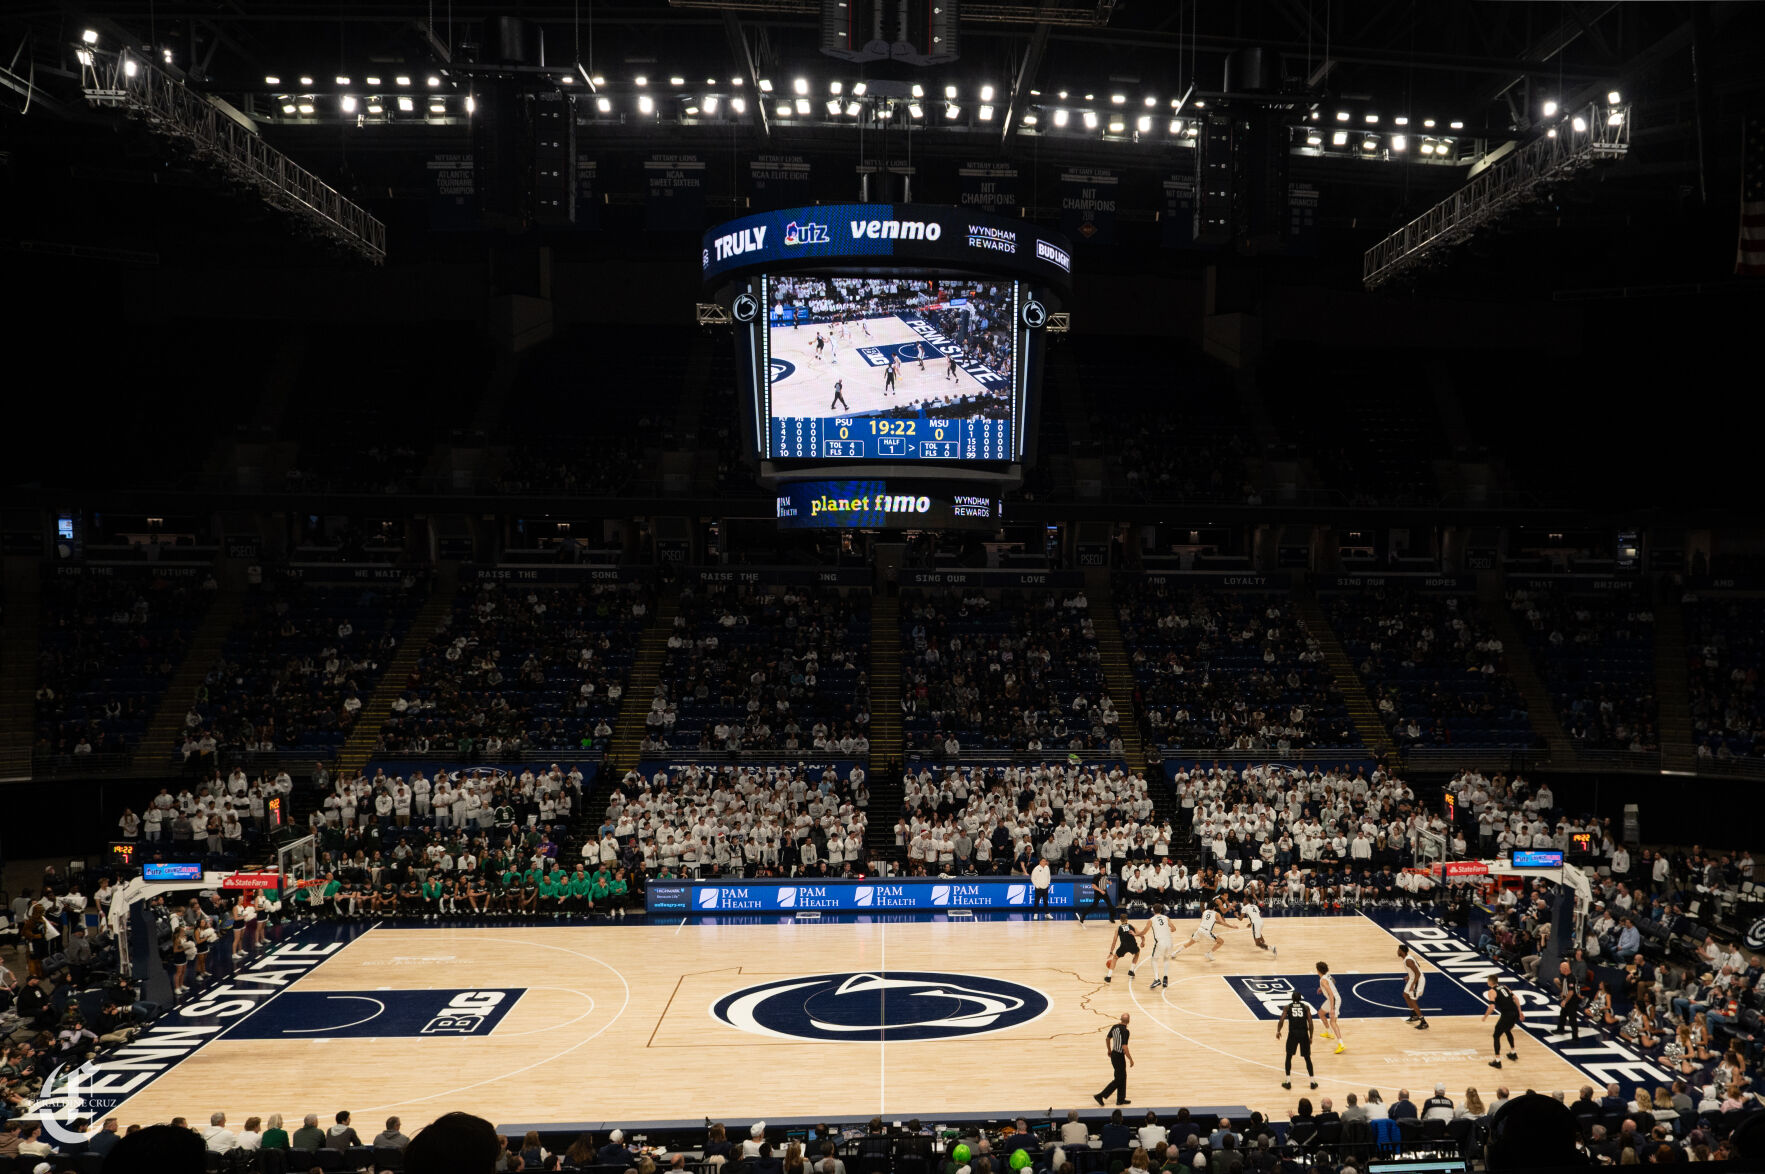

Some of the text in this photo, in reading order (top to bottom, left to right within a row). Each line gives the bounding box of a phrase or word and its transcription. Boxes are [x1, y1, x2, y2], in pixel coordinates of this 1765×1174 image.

[666, 170, 684, 178] NCAA
[981, 182, 996, 193] NIT
[961, 193, 1016, 205] CHAMPIONS
[1082, 188, 1096, 200] NIT
[1062, 198, 1116, 212] CHAMPIONS
[850, 220, 942, 241] venmo
[968, 224, 1016, 241] WYNDHAM
[714, 226, 767, 262] TRULY
[968, 238, 1016, 254] REWARDS
[1038, 243, 1070, 270] BUD LIGHT
[906, 320, 1002, 383] PENN STATE
[840, 427, 848, 439] 0
[870, 420, 916, 435] 19:22
[935, 428, 944, 440] 0
[811, 495, 869, 516] planet
[954, 496, 989, 506] WYNDHAM
[954, 507, 989, 517] REWARDS
[662, 550, 685, 561] PSECU
[1081, 554, 1103, 565] PSECU
[1469, 558, 1491, 568] PSECU
[57, 568, 113, 576] FOR THE
[114, 846, 133, 854] 19:22
[122, 855, 128, 864] 7
[722, 889, 749, 898] PAM
[800, 888, 826, 897] PAM
[876, 887, 903, 896] PAM
[953, 886, 979, 895] PAM
[1029, 885, 1054, 894] PM
[722, 900, 762, 908] HEALTH
[800, 898, 839, 907] HEALTH
[876, 897, 916, 906] HEALTH
[953, 896, 992, 905] HEALTH
[1389, 927, 1520, 983] PENN
[179, 942, 344, 1017] STATE
[1292, 1008, 1303, 1017] 55
